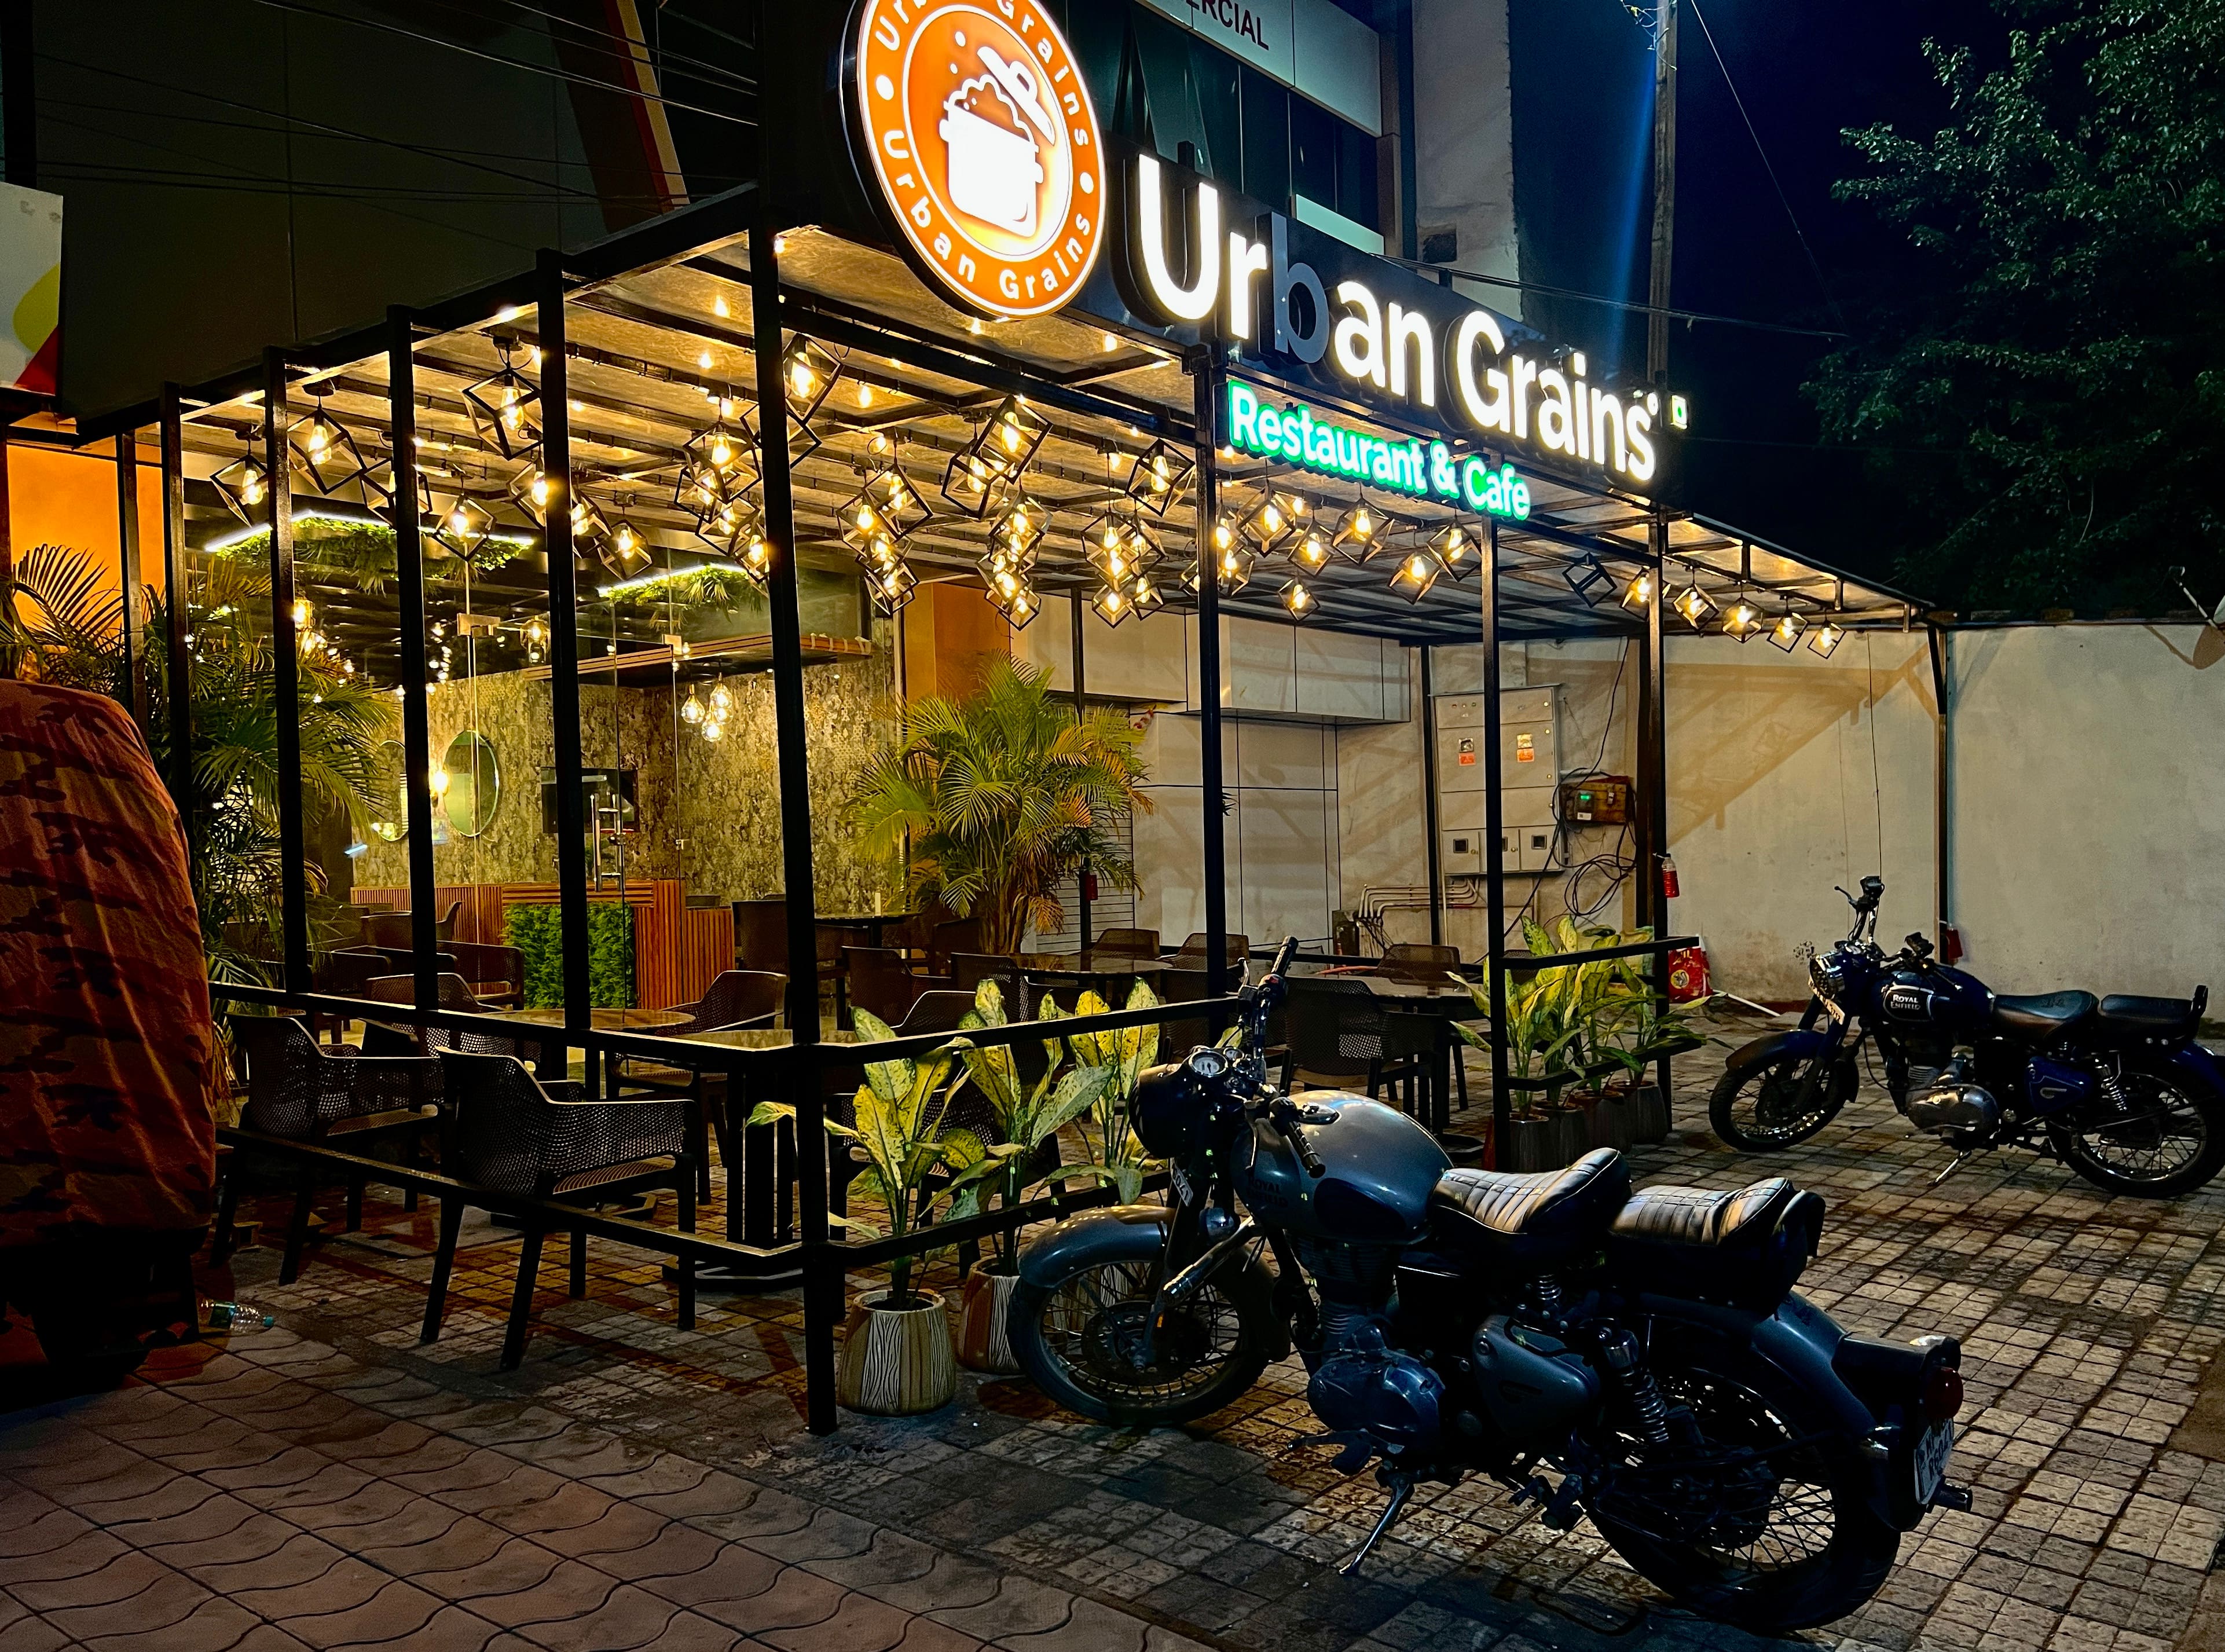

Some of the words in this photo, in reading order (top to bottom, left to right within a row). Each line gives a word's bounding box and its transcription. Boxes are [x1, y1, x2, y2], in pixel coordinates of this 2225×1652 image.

[996, 0, 1090, 146] Grains
[884, 130, 977, 283] Urban
[999, 213, 1091, 300] Grains
[1138, 153, 1436, 407] Urban
[1456, 310, 1656, 482] Grains
[1229, 380, 1428, 494] Restaurant
[1430, 439, 1460, 499] &
[1463, 455, 1531, 521] Cafe
[1890, 1001, 1921, 1010] ENFIELD
[1893, 994, 1918, 1003] ROYAL
